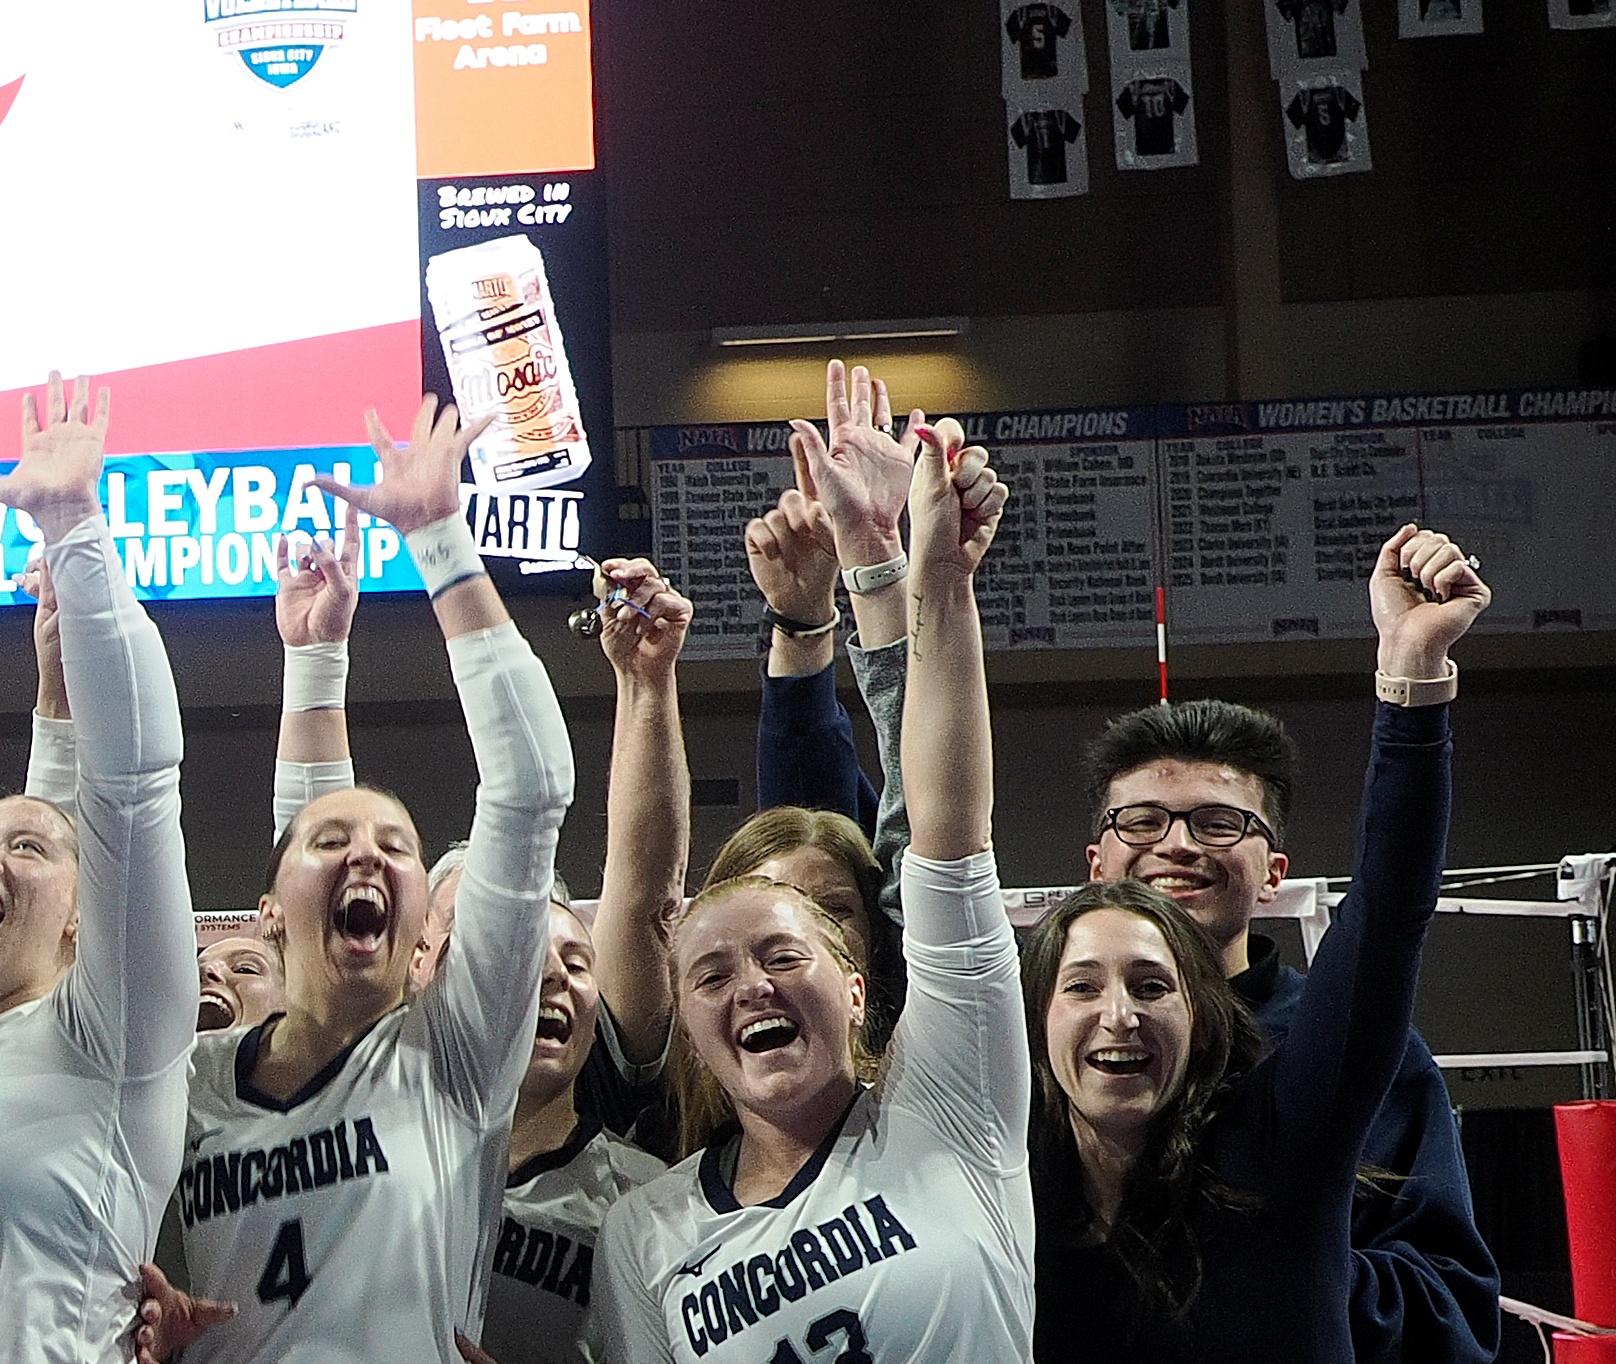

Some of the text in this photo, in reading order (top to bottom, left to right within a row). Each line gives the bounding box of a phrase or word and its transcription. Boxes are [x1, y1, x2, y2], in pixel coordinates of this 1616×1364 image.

[453, 44, 547, 70] Arena
[437, 182, 571, 207] BREWED IN
[439, 203, 573, 230] SIOUX CITY
[1258, 389, 1616, 428] WOMEN'S BASKETBALL CHAMPI
[994, 412, 1129, 440] CHAMPIONS
[194, 914, 257, 924] ORMANCE
[179, 1115, 390, 1229] CONCORDIA
[256, 1217, 316, 1309] 4
[682, 1194, 917, 1357] CONCORDIA
